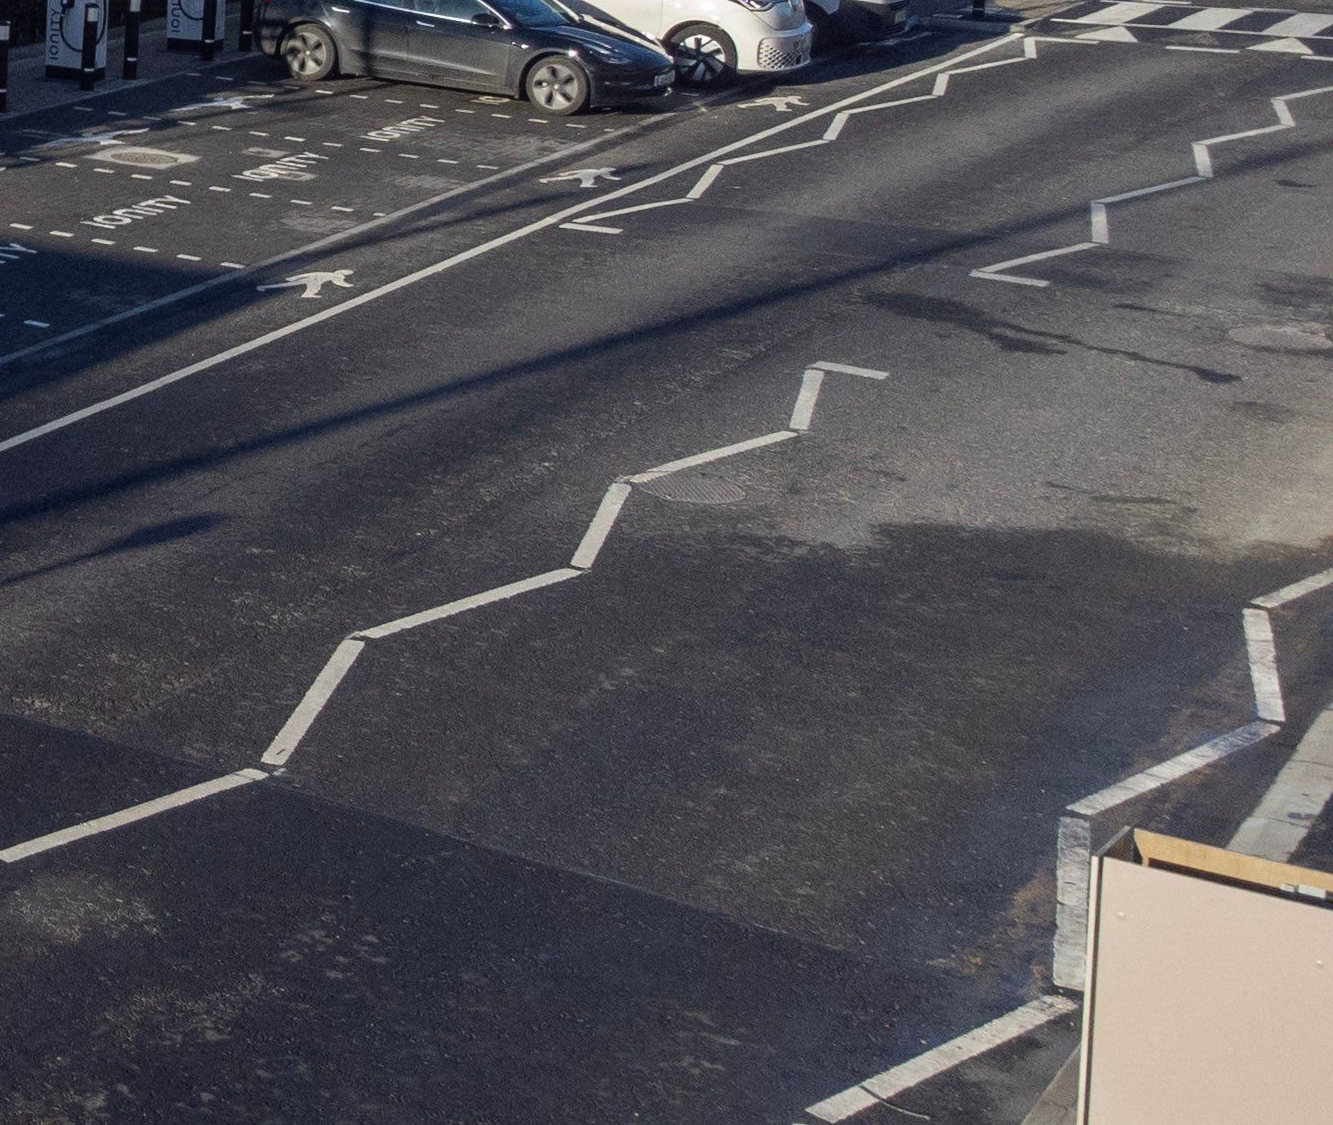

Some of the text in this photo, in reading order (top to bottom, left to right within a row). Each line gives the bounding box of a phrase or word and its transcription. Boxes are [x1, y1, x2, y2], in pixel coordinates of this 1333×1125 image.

[49, 9, 61, 60] IONITY
[359, 115, 445, 142] IONITY
[231, 151, 330, 182] IONITY
[81, 194, 191, 230] IONITY
